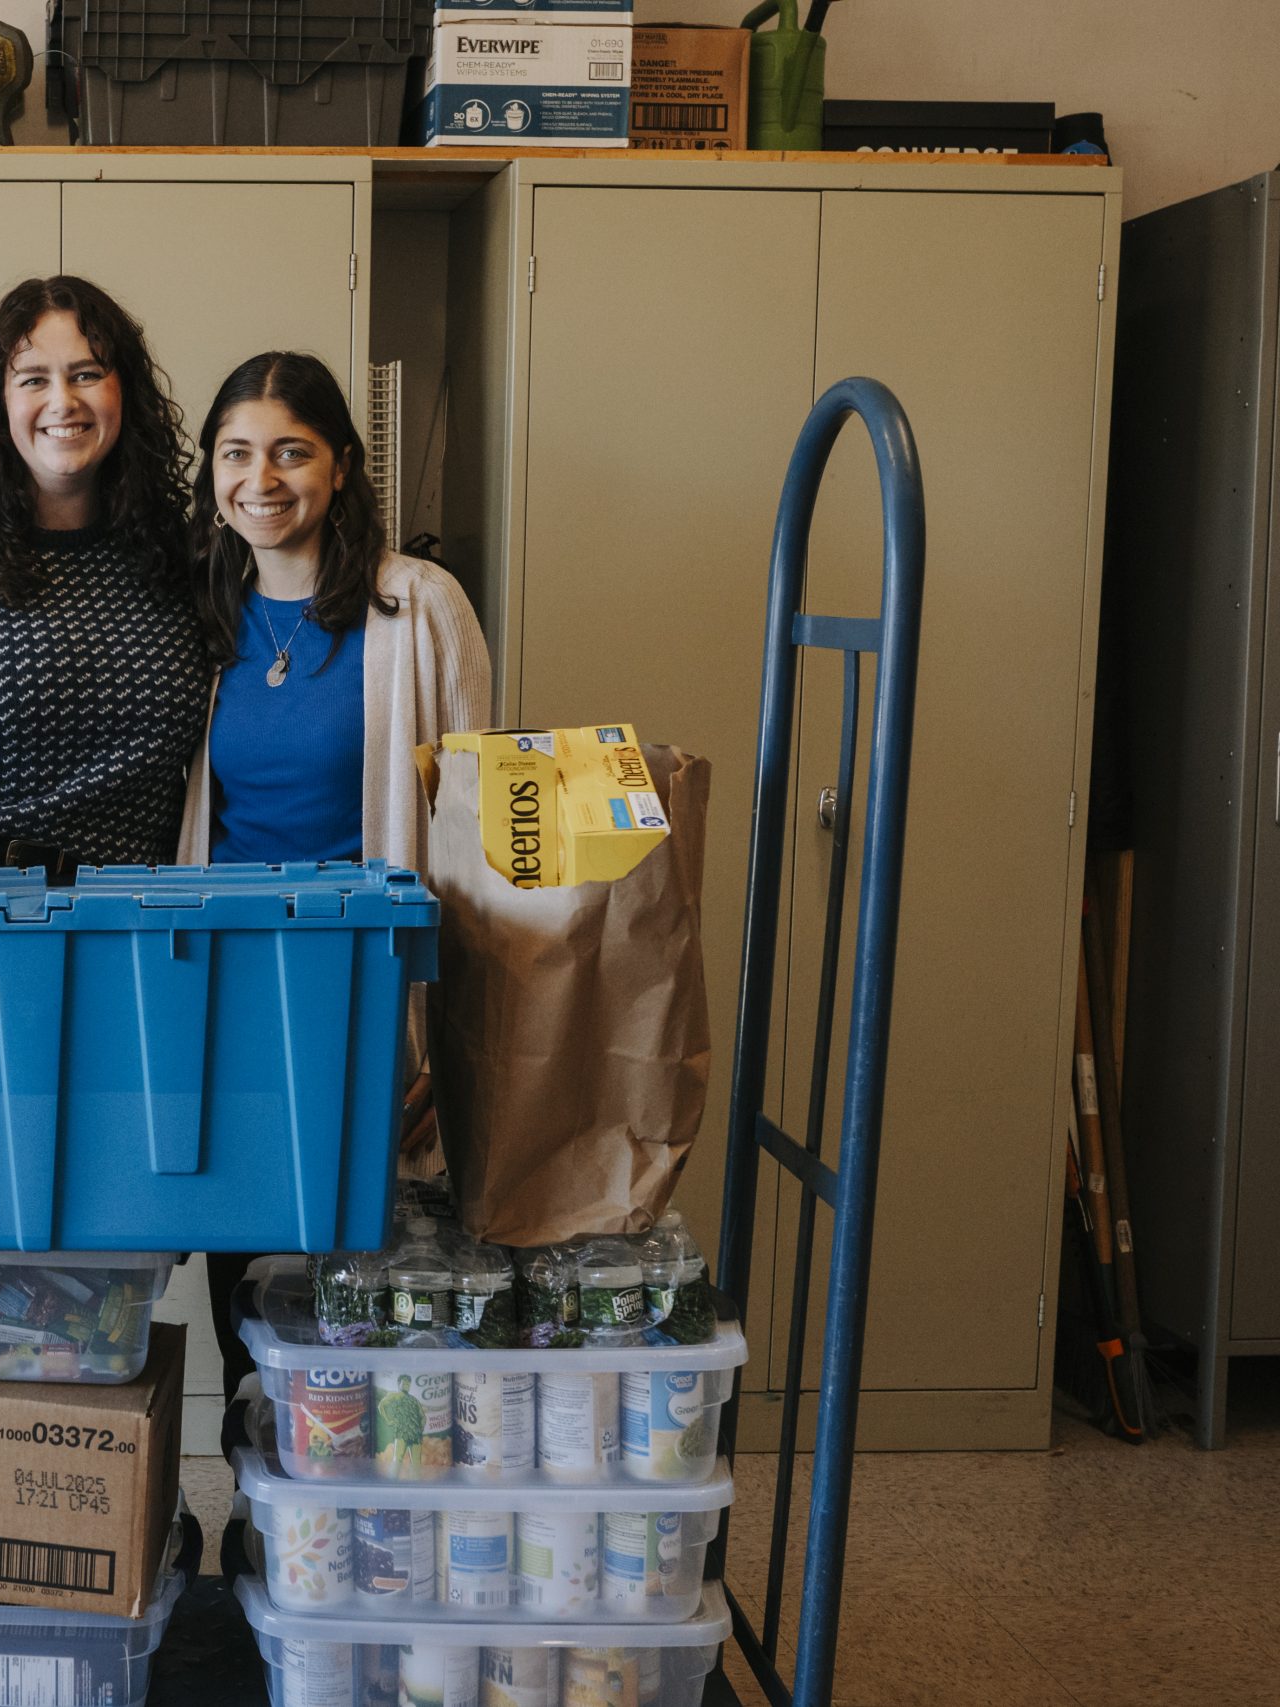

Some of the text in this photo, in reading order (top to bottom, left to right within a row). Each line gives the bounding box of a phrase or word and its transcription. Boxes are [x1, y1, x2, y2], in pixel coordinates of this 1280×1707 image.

[308, 1393, 354, 1402] RED KIDNEY
[14, 1468, 107, 1496] 04JUL2025
